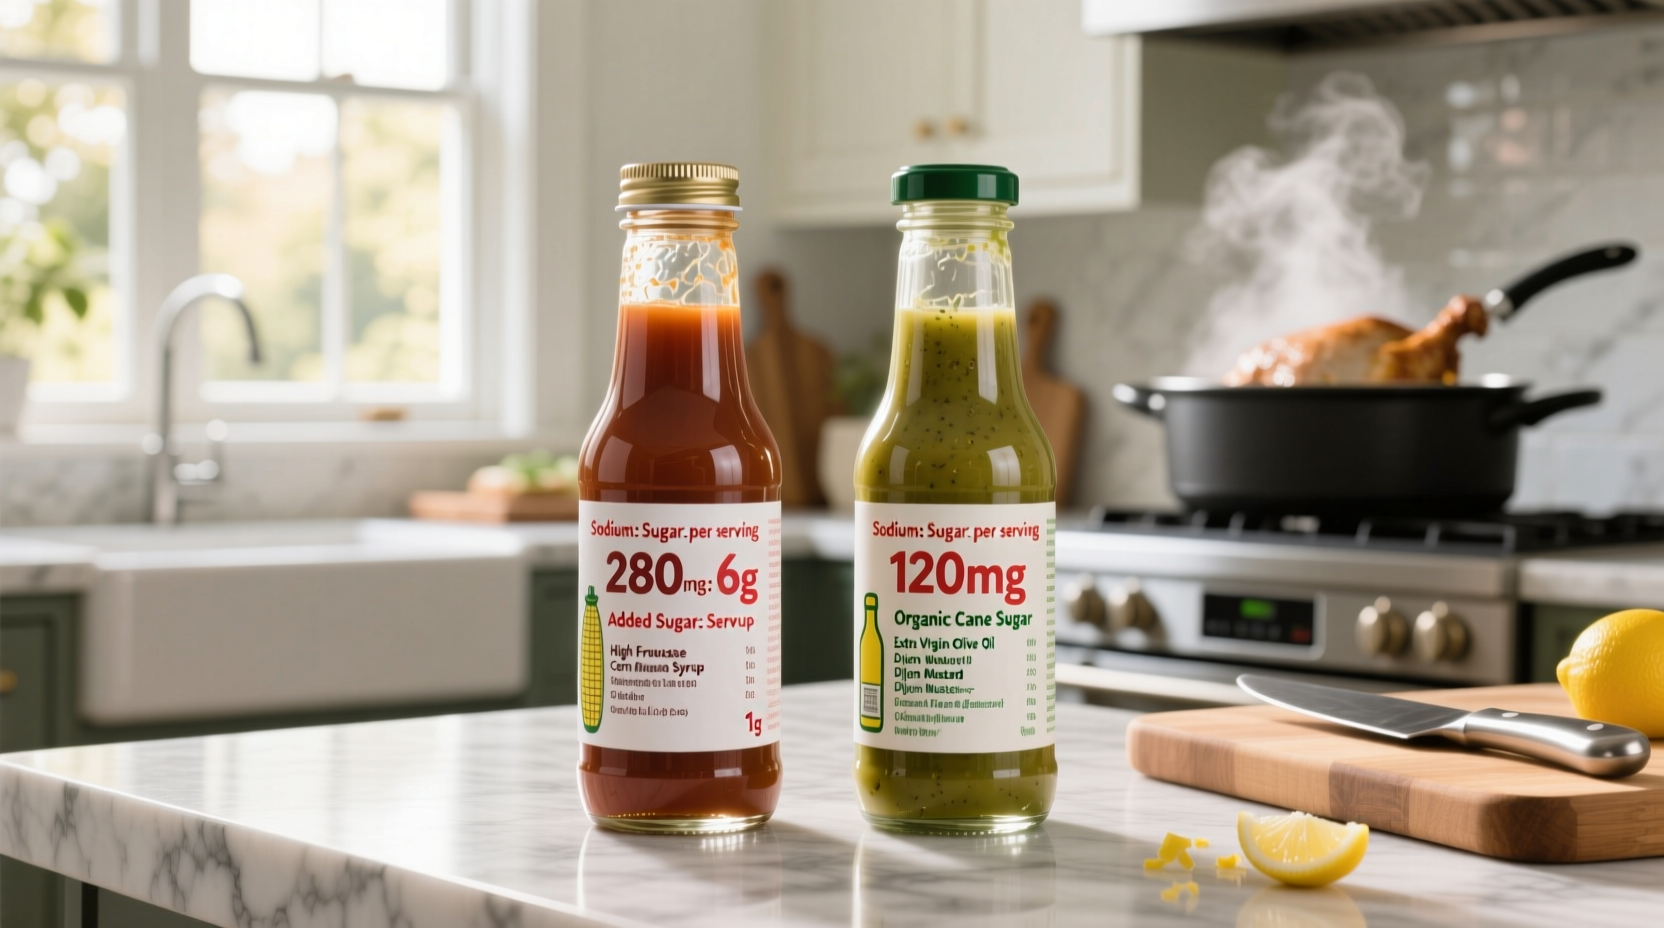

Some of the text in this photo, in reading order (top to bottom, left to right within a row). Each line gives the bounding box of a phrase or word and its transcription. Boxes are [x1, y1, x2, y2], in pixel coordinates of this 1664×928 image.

[690, 527, 712, 543] per
[873, 521, 923, 537] Sodium:
[974, 527, 996, 543] per
[717, 554, 758, 604] 6g
[890, 551, 1026, 605] 120mg
[608, 611, 651, 628] Added
[895, 610, 1032, 630] Organic Cane Sugar
[982, 637, 994, 649] Oil
[745, 712, 761, 736] 1g
